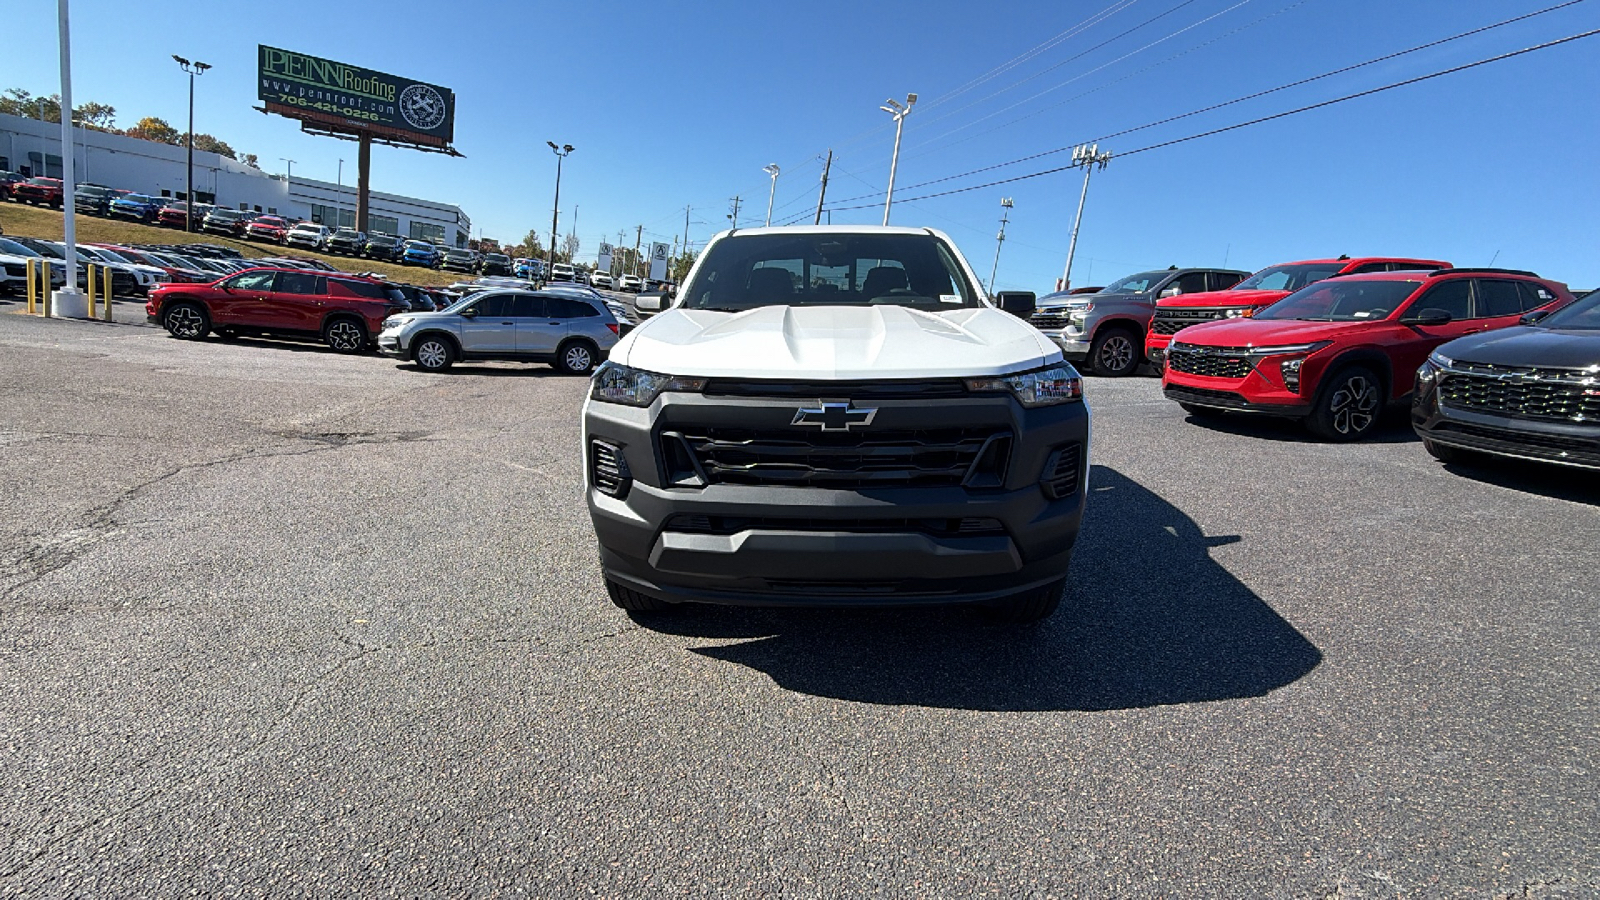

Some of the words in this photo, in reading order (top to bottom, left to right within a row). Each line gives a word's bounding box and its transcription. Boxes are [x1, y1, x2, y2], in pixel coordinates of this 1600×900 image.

[263, 47, 360, 88] PENN
[344, 69, 396, 102] Roofing
[262, 79, 394, 115] www.pennroof.com
[278, 93, 379, 121] 706-421-0226
[1155, 310, 1214, 318] CHEVROLET
